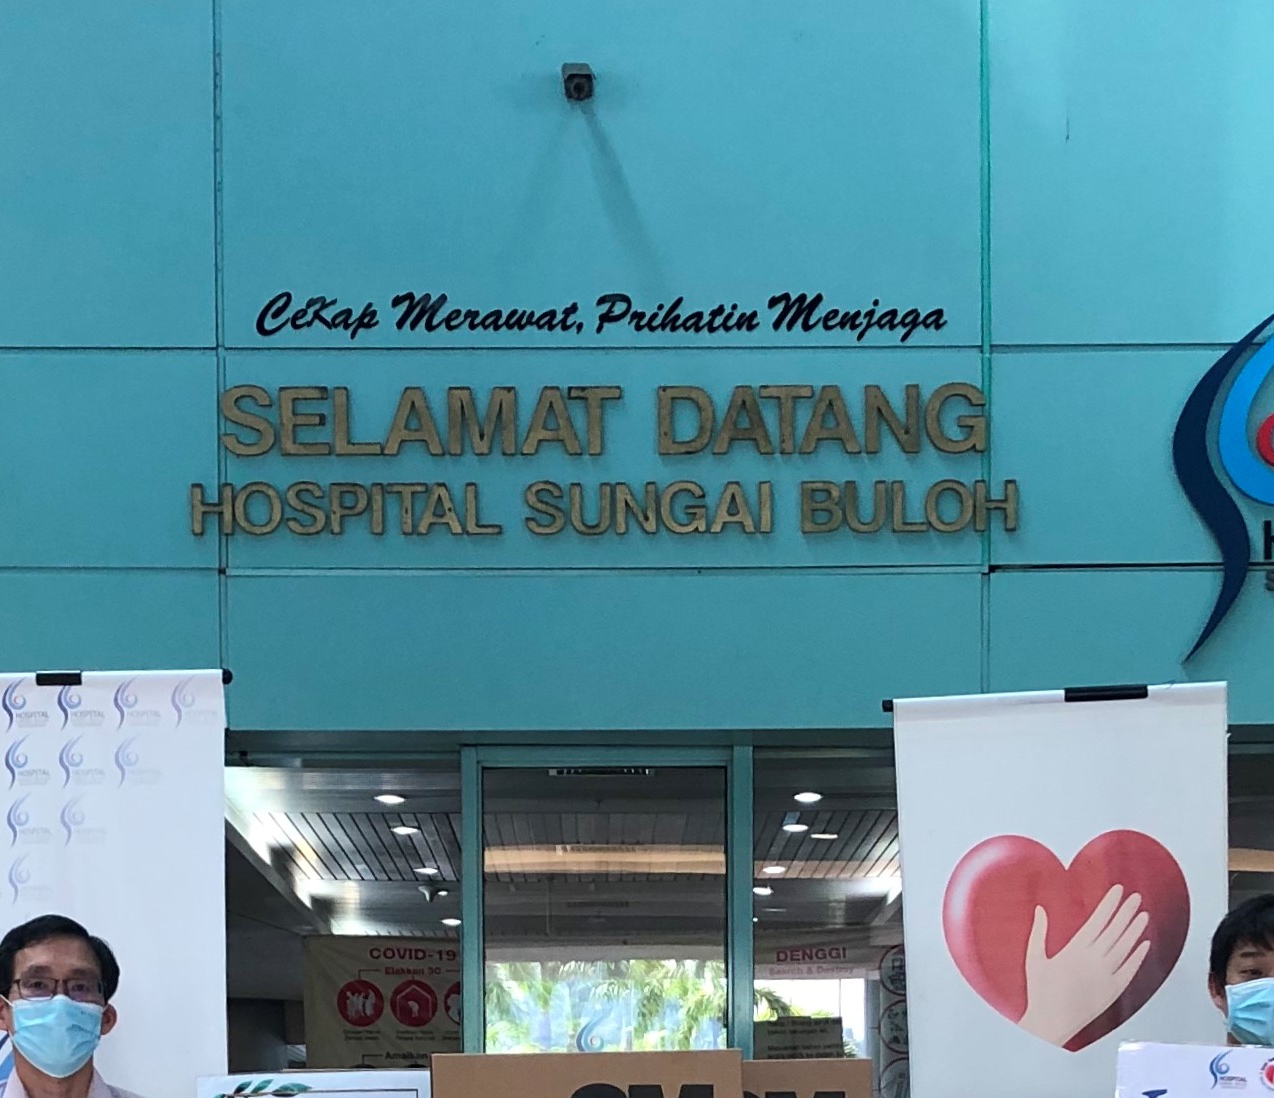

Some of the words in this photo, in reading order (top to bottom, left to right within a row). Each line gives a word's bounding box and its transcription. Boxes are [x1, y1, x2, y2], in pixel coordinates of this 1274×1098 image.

[391, 291, 584, 336] Merawat,
[595, 295, 760, 335] Prihatin
[768, 293, 948, 343] Menjaga
[220, 386, 622, 458] SELAMAT
[656, 383, 988, 456] DATANG
[192, 482, 501, 537] HOSPITAL
[525, 481, 773, 535] SUNGAI
[801, 479, 1018, 534] BULOH
[369, 947, 457, 961] COVID-19
[776, 946, 847, 962] DENGGI
